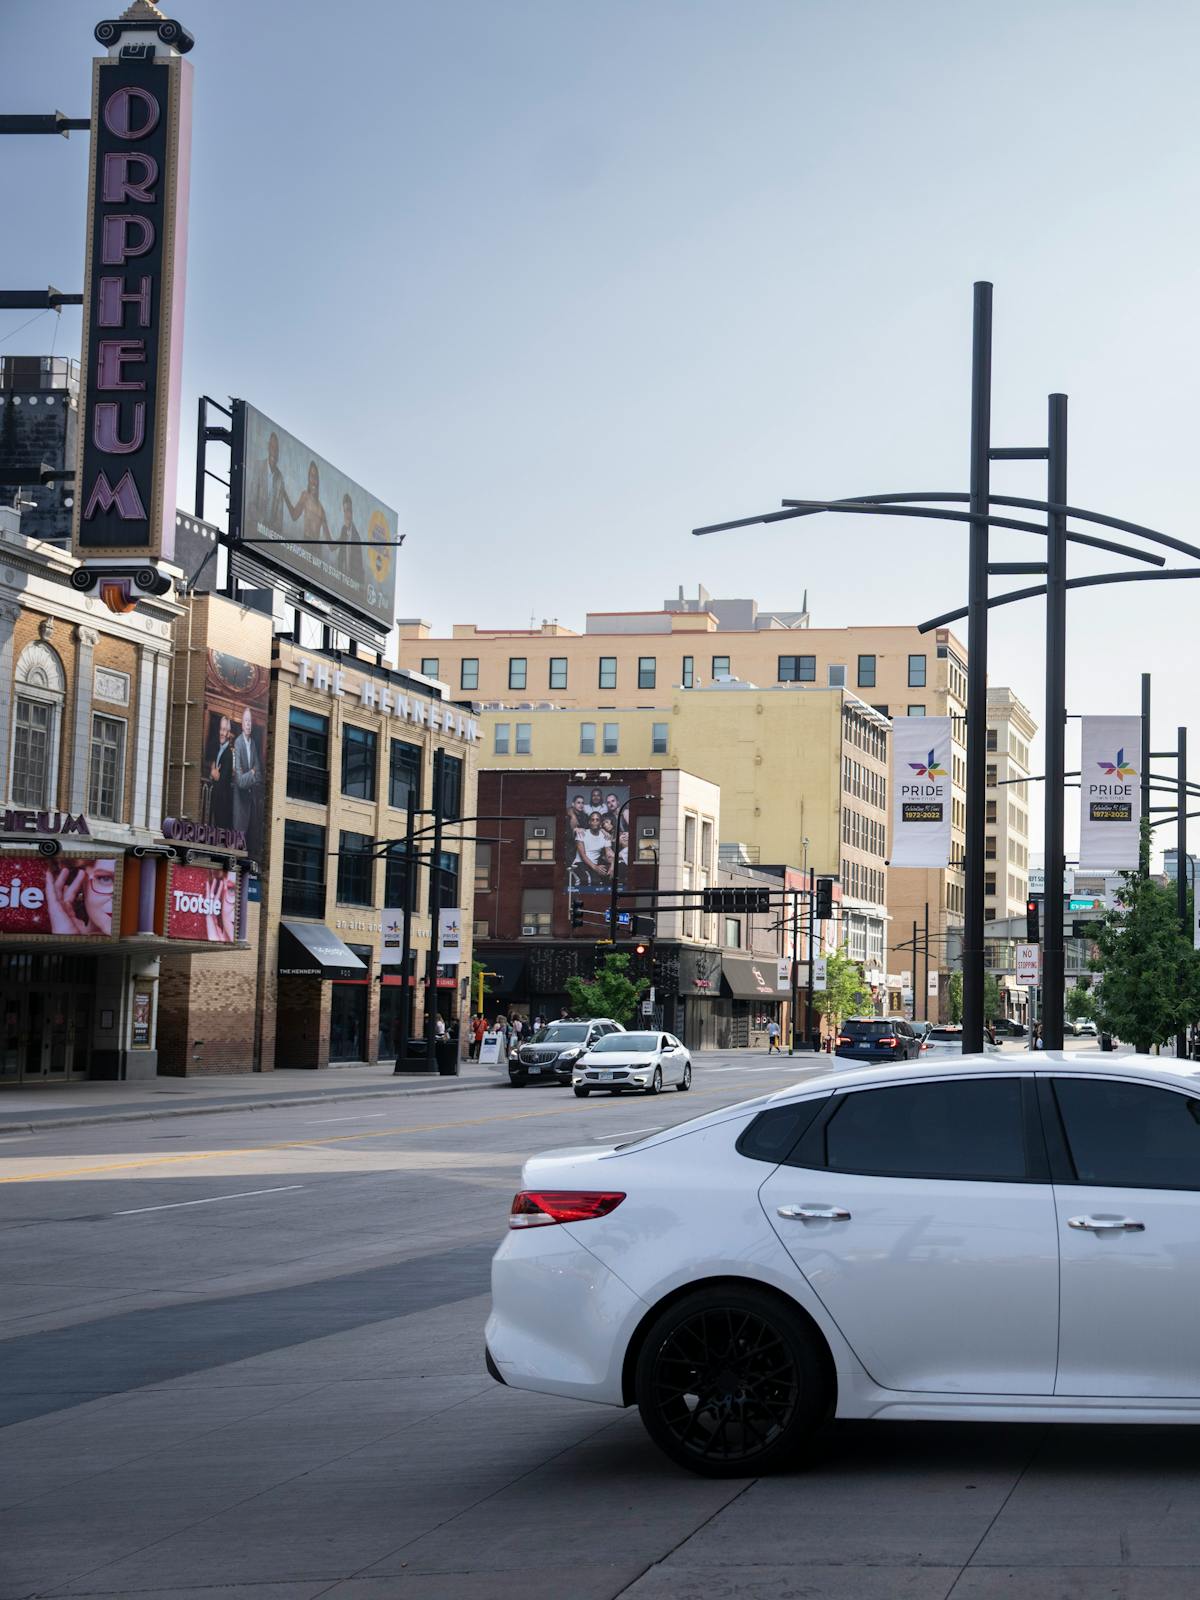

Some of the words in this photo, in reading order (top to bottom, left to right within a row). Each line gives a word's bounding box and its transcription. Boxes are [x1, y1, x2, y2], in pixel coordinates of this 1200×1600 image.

[83, 87, 160, 521] ORPHEUM
[299, 656, 346, 697] THE
[360, 681, 478, 742] HENNEPIN
[902, 785, 943, 796] PRIDE
[1090, 784, 1132, 796] PRIDE
[166, 818, 247, 850] ORPHEUM
[174, 890, 222, 916] Tootsie
[1023, 950, 1032, 958] NO
